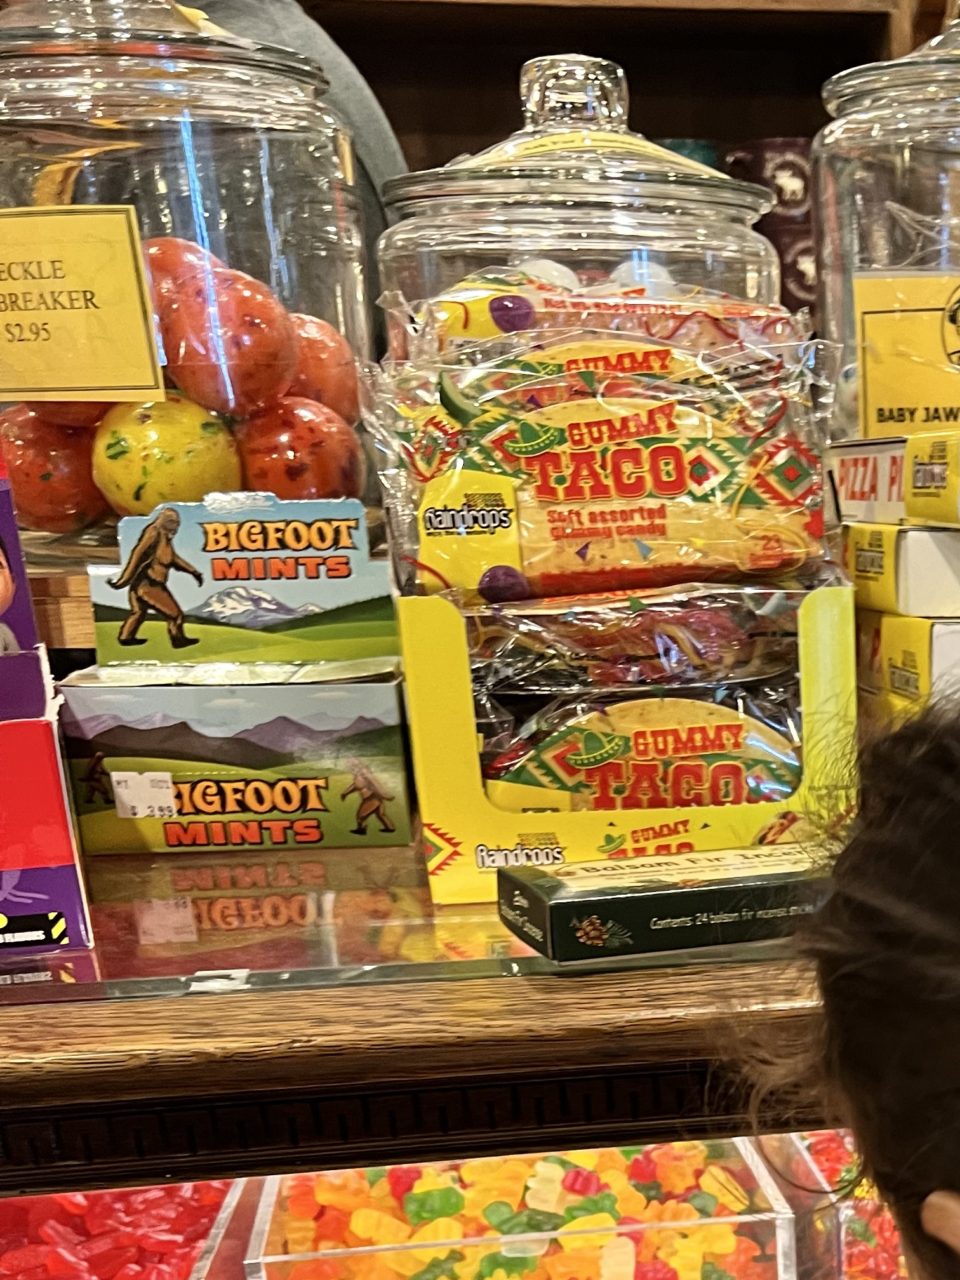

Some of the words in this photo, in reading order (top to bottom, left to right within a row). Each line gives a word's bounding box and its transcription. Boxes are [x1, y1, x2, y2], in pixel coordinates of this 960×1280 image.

[5, 321, 51, 343] $2.95
[565, 399, 679, 447] GUMMY
[875, 405, 916, 424] BABY
[522, 443, 692, 503] TACO
[838, 456, 878, 502] PIZZA
[547, 509, 583, 525] Soft
[588, 503, 667, 524] assorted
[200, 517, 361, 553] BIGFOOT
[615, 521, 667, 537] candy
[210, 555, 354, 582] MINTS
[631, 721, 746, 759] GUMMY
[584, 759, 747, 811] TACO
[163, 818, 324, 848] MINTS
[630, 818, 690, 844] GUMMY
[580, 857, 680, 874] Balsam
[688, 854, 724, 866] Fir
